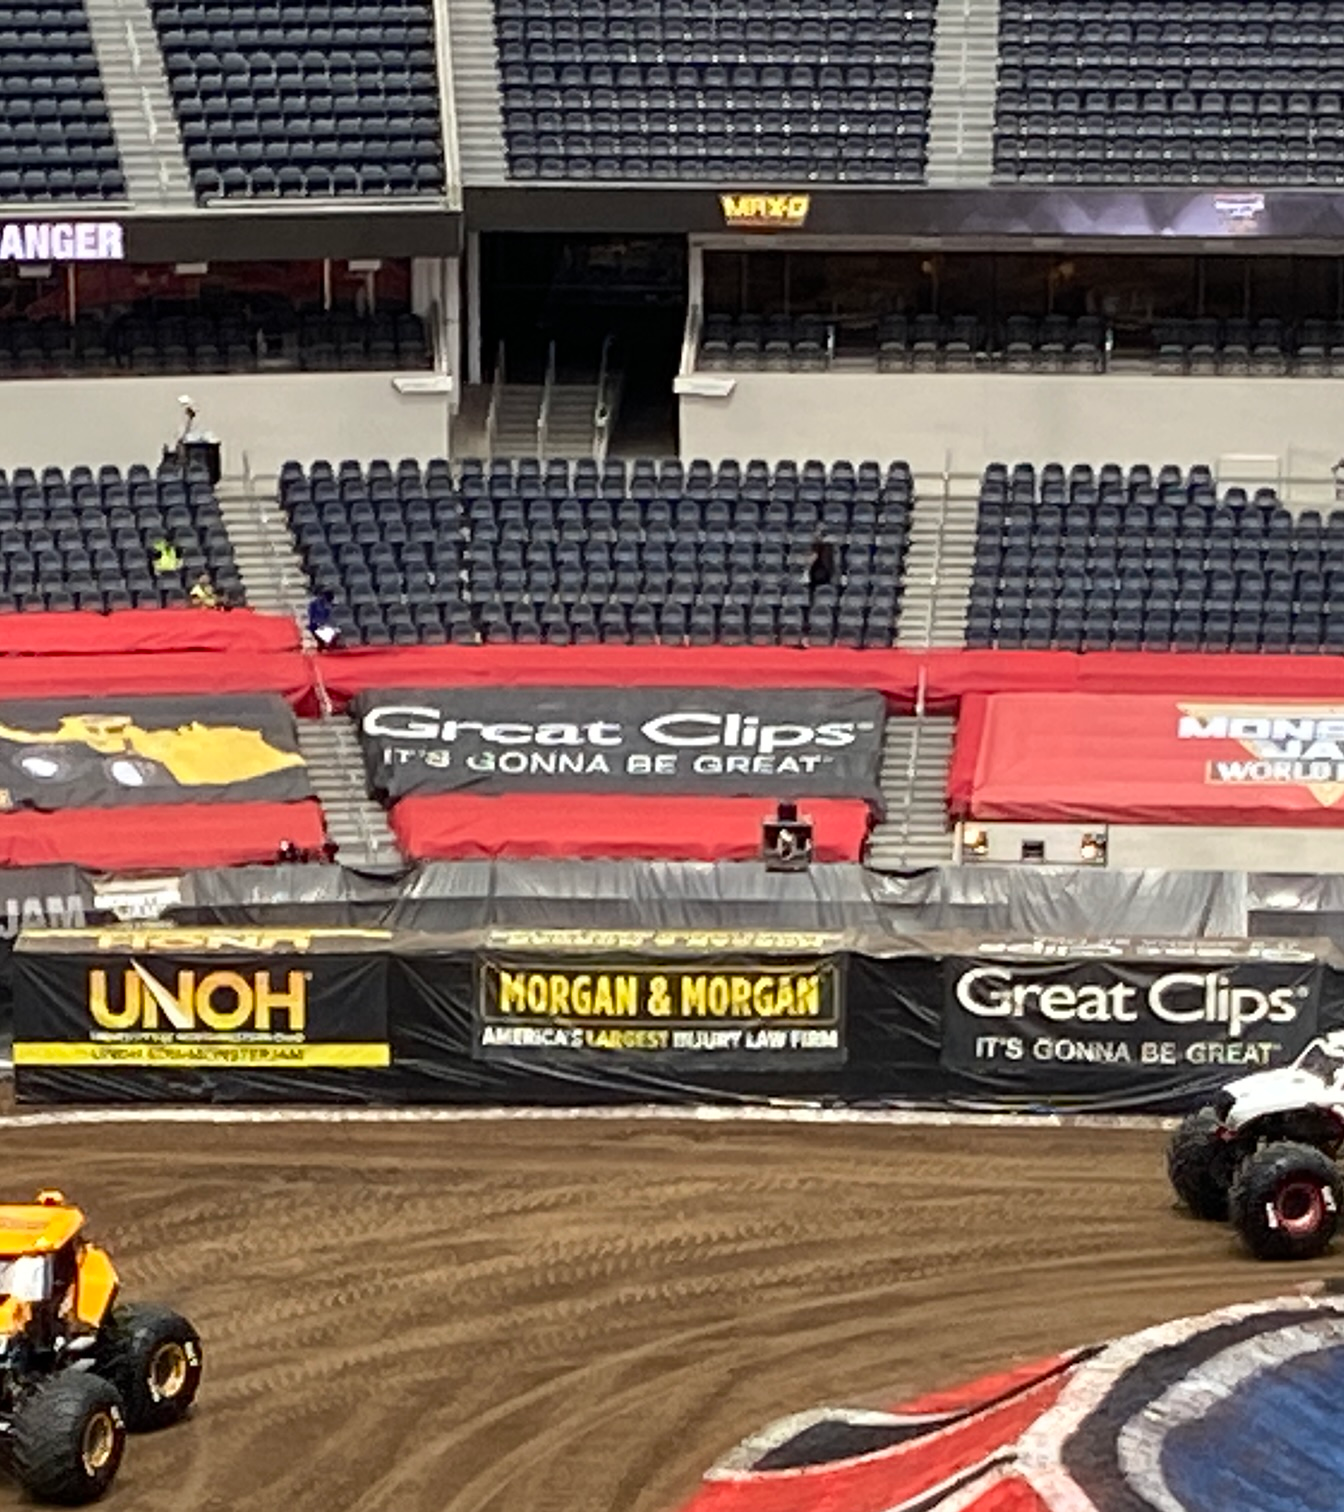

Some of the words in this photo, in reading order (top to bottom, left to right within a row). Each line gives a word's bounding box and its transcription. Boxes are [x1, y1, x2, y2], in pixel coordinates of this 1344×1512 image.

[362, 705, 623, 746] Great
[640, 711, 856, 753] Clips
[382, 747, 451, 768] IT'S
[466, 750, 611, 774] GONNA
[626, 754, 678, 774] BE
[692, 754, 818, 774] GREAT
[1216, 760, 1332, 782] WORLD
[89, 960, 306, 1030] UNOH
[498, 971, 638, 1016] MORGAN
[647, 975, 672, 1017] &
[680, 974, 820, 1017] MORGAN
[956, 966, 1138, 1022] Great
[1148, 970, 1299, 1037] Clips
[481, 1026, 584, 1048] AMERICA'S
[585, 1029, 669, 1049] LARGEST
[745, 1030, 788, 1049] LAW
[975, 1036, 1024, 1060] IT'S
[1032, 1038, 1131, 1064] GONNA
[1140, 1041, 1178, 1065] BE
[1185, 1042, 1274, 1066] GREAT
